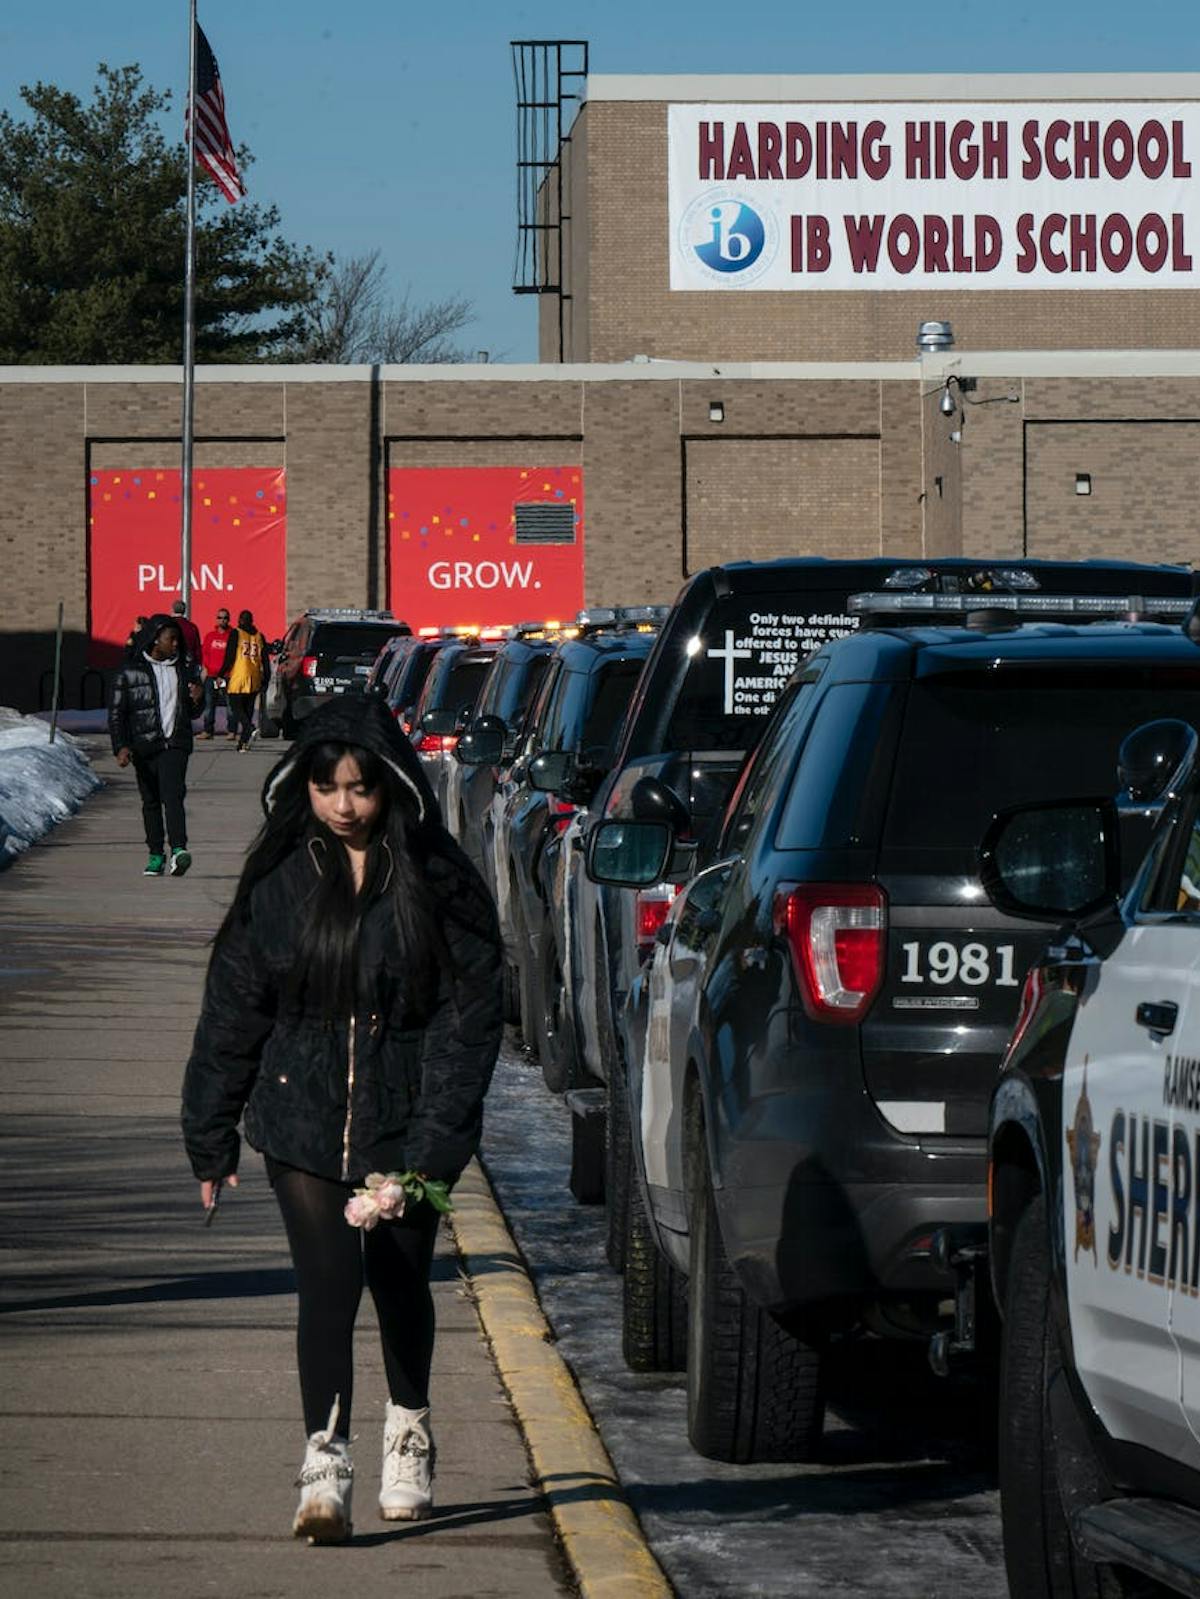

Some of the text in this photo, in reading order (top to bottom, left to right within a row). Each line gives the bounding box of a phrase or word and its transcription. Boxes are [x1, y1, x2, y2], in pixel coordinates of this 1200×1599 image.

[699, 119, 1192, 180] HARDING HIGH SCHOOL
[790, 213, 1192, 274] IB WORLD SCHOOL
[138, 563, 234, 592] PLAN.
[428, 561, 541, 589] GROW.
[749, 613, 860, 628] Only two defining
[752, 626, 855, 638] forces have eve
[735, 638, 782, 649] offered
[784, 638, 798, 650] to
[759, 651, 798, 664] JESUS
[734, 691, 760, 703] One
[734, 704, 751, 715] the
[901, 941, 1019, 986] 1981
